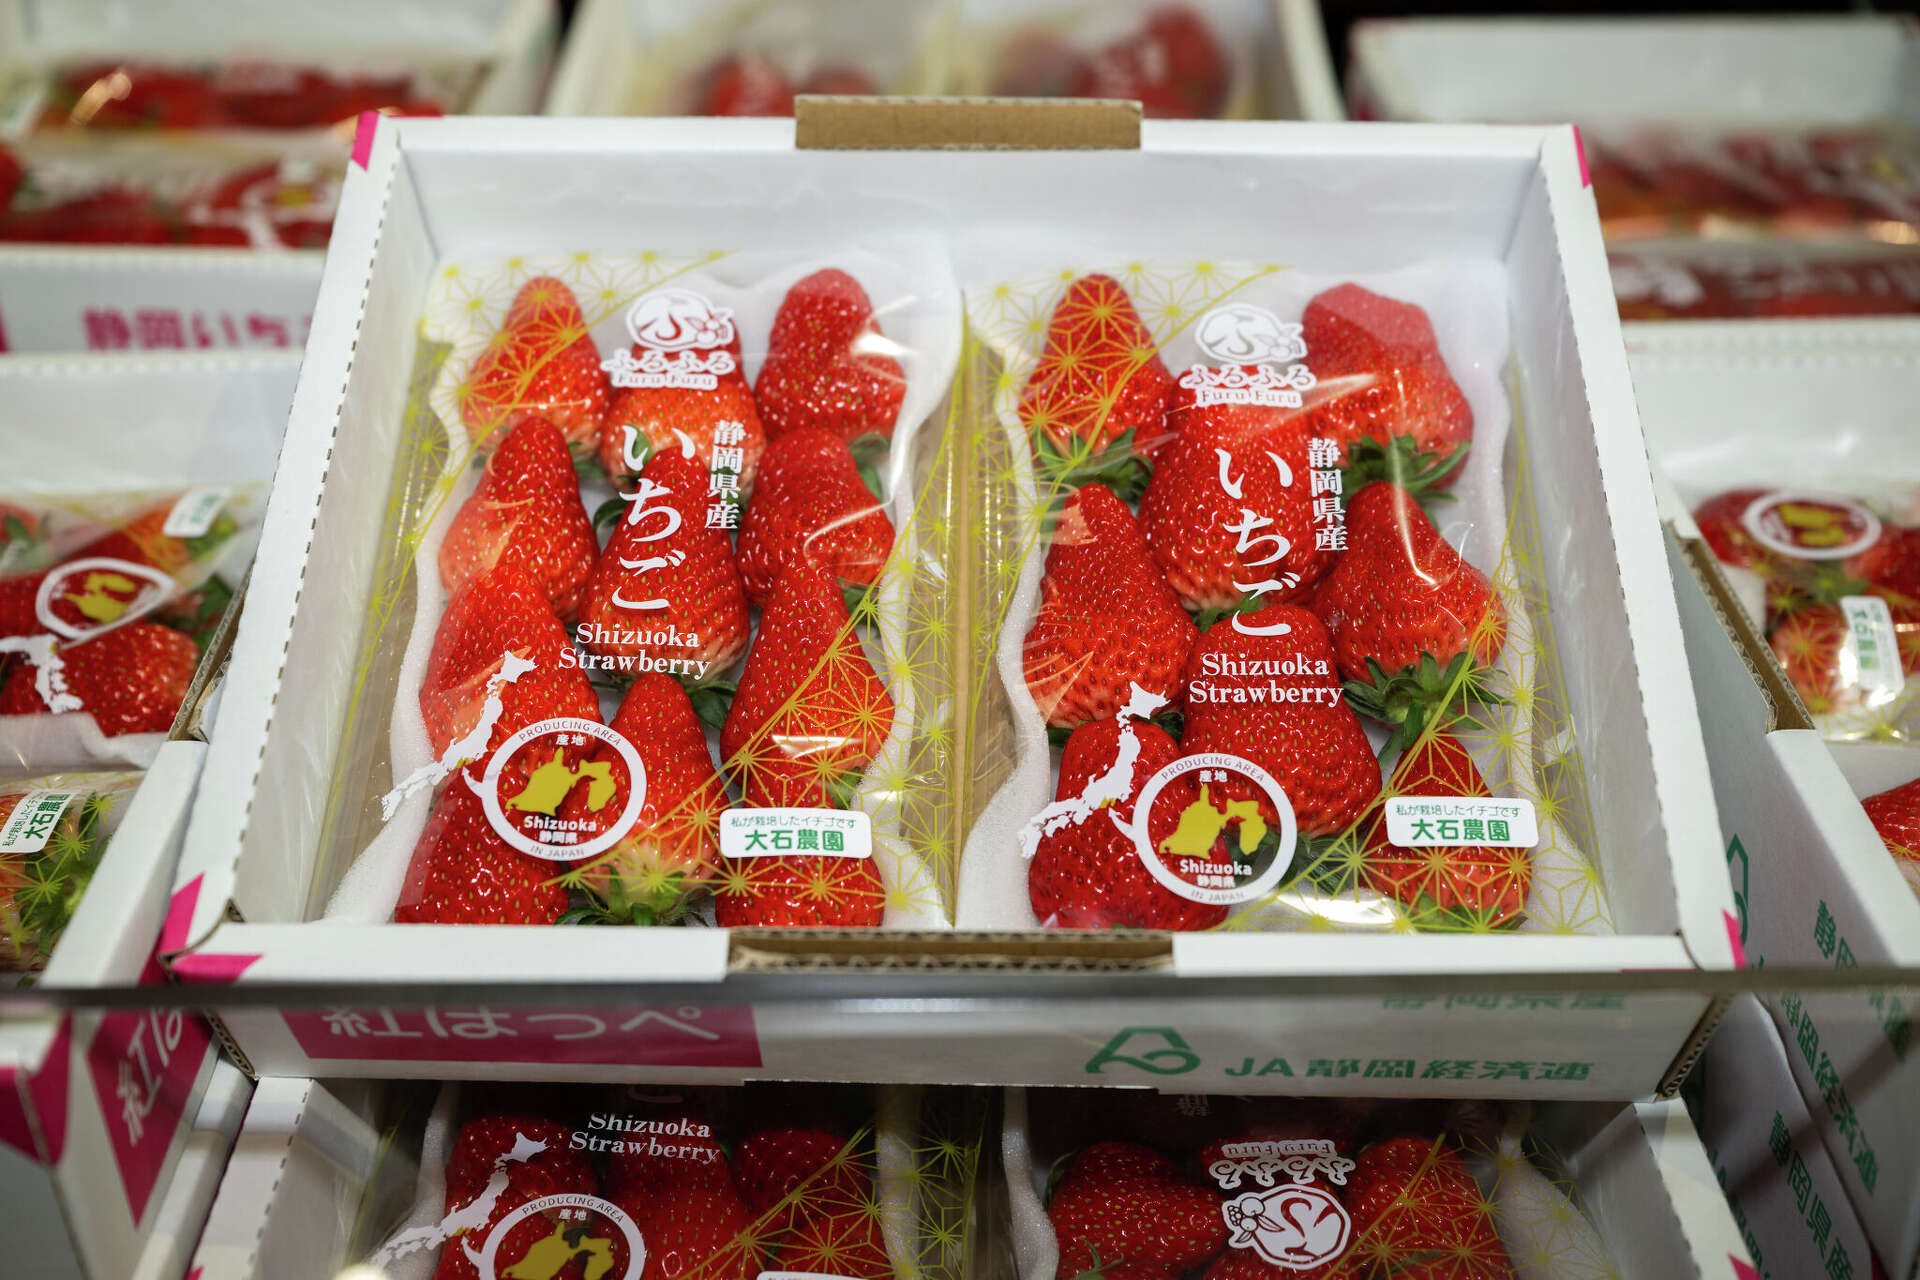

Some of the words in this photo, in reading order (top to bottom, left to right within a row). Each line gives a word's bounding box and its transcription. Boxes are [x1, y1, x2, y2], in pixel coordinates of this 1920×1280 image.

[704, 419, 748, 530] 静岡県産
[1306, 436, 1349, 552] 静岡県産
[611, 425, 696, 610] いちご
[1214, 447, 1301, 637] いちご
[575, 622, 700, 648] Shizuoka
[558, 647, 712, 681] Strawberry
[1202, 652, 1330, 677] Shizuoka
[1189, 680, 1344, 707] Strawberry
[518, 720, 591, 742] PRODUCING
[592, 727, 622, 746] AREA
[1161, 756, 1232, 780] PRODUCING
[1234, 761, 1265, 782] AREA
[523, 815, 598, 832] Shizuoka
[1396, 804, 1521, 818] 私が栽培したイチゴです
[744, 828, 845, 851] 大石農園
[1410, 818, 1511, 842] 大石農園
[1179, 859, 1253, 876] Shizuoka
[587, 1112, 711, 1138] Shizuoka
[568, 1131, 721, 1165] Strawberry
[521, 1195, 595, 1215] PRODUCING
[596, 1202, 624, 1224] AREA
